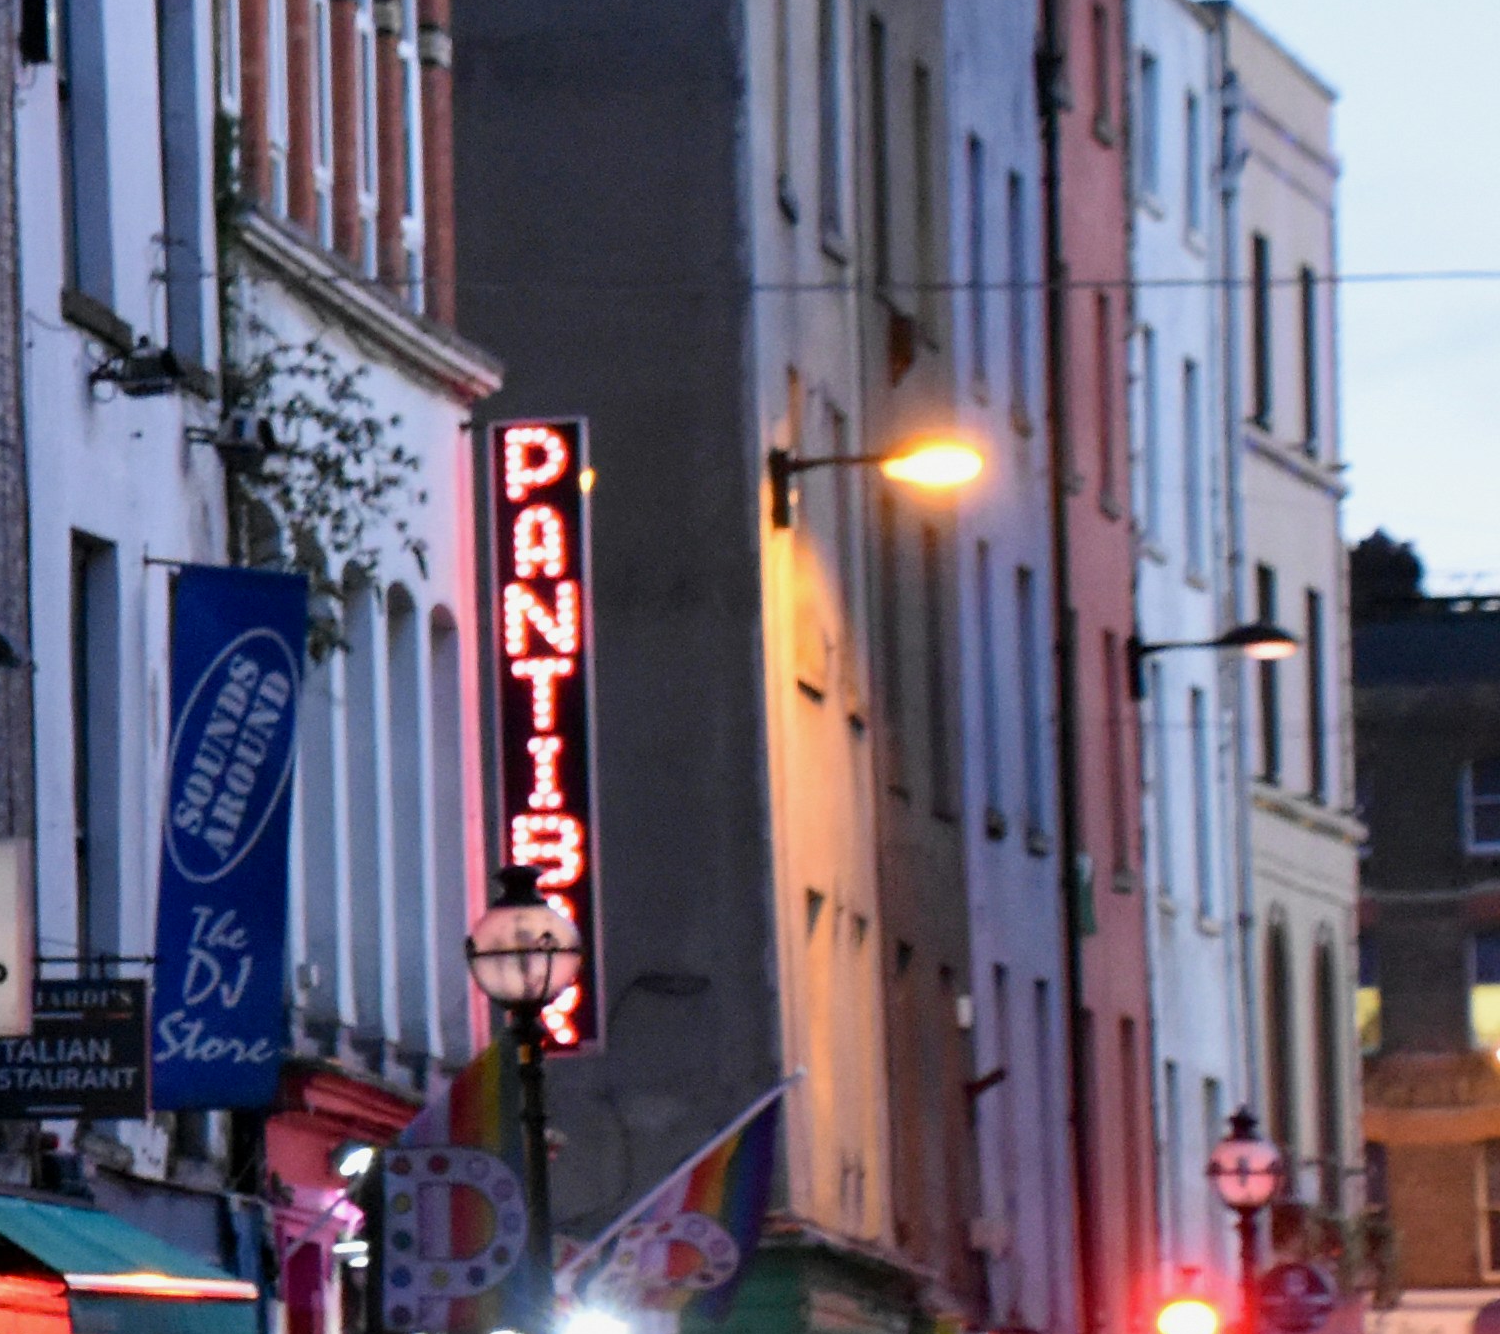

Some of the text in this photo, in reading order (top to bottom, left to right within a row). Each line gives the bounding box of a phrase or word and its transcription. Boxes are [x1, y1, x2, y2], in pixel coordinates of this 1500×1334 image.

[173, 653, 259, 836] SOUNDS
[203, 670, 291, 862] AROUND
[503, 424, 583, 1047] PANTIB
[183, 947, 253, 1009] DJ
[191, 905, 250, 950] The
[153, 1009, 276, 1063] Store
